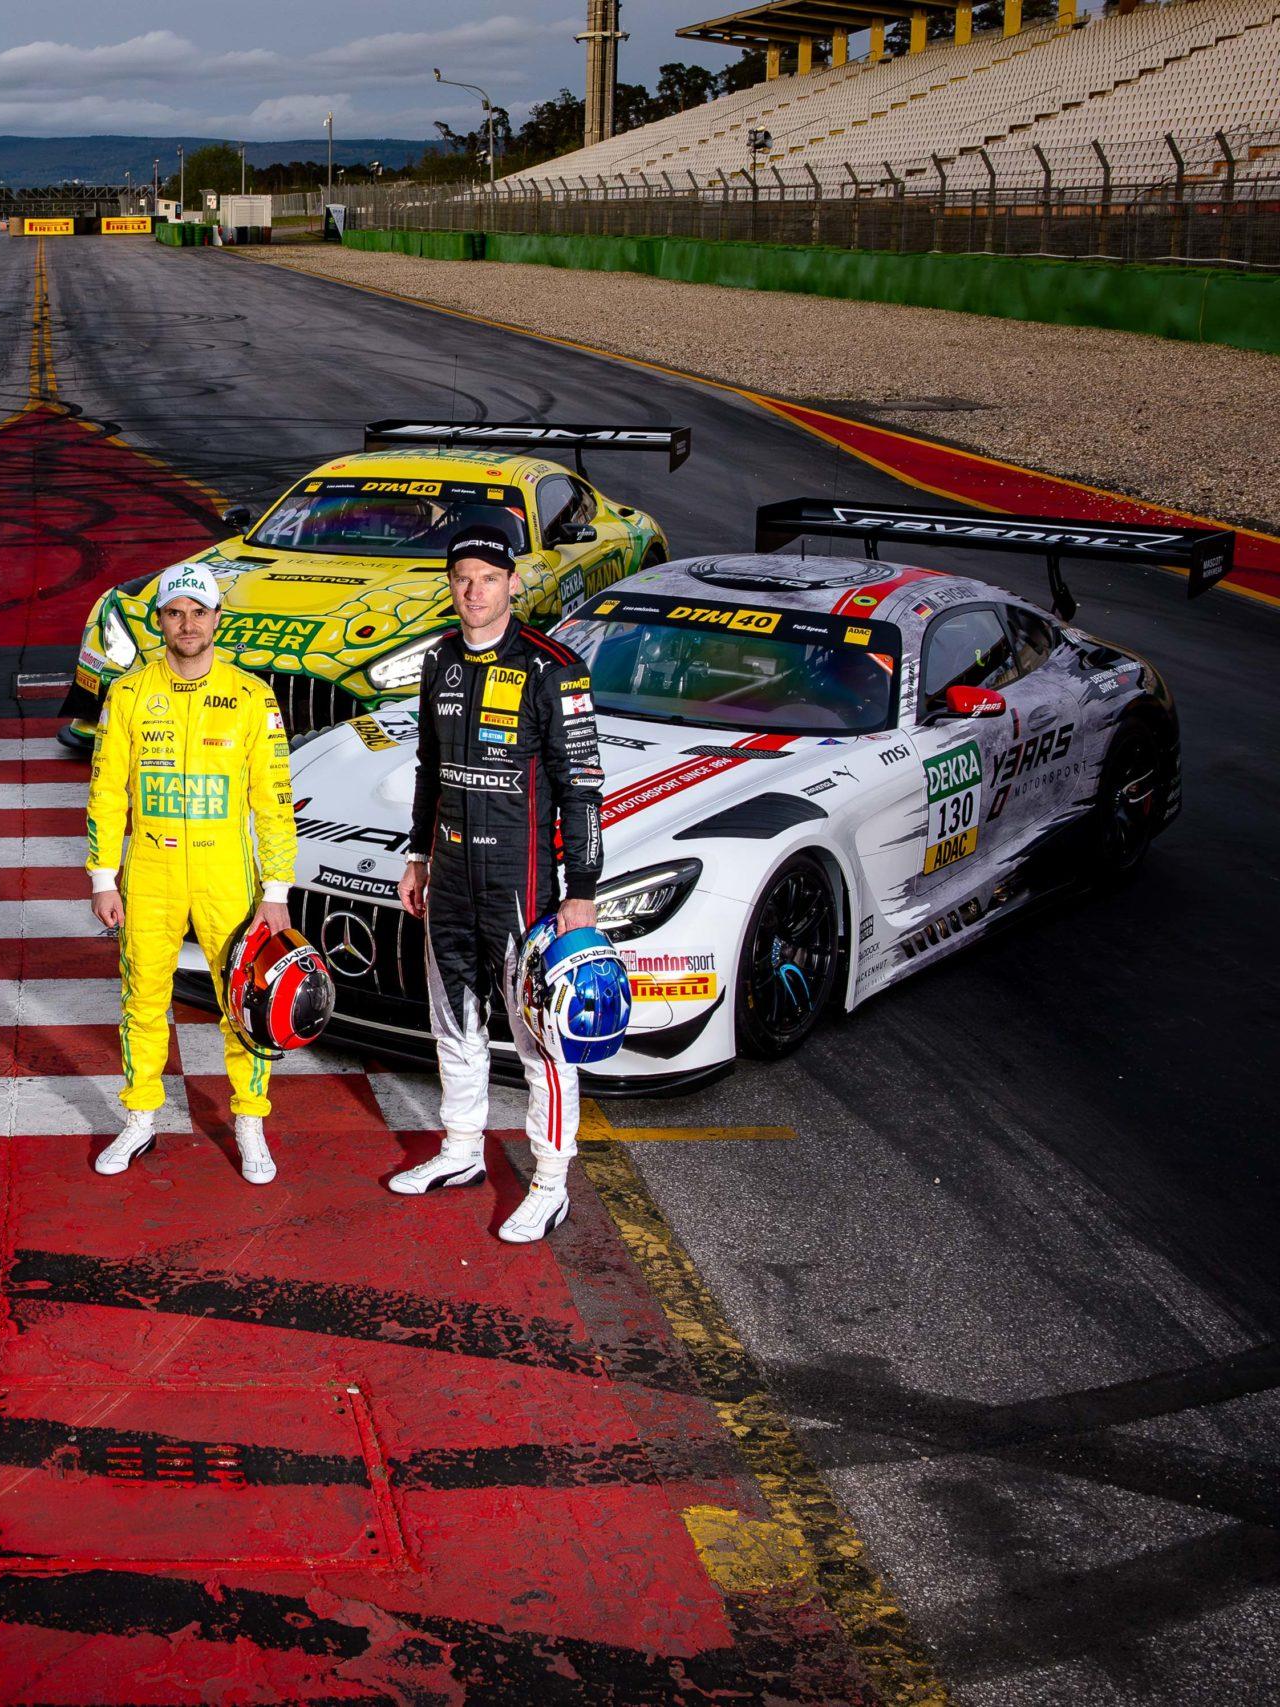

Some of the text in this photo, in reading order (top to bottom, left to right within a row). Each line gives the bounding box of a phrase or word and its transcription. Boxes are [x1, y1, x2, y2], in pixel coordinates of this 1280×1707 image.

[28, 220, 72, 232] PIRELLI
[106, 219, 148, 231] PIRELLI
[492, 427, 671, 442] AMG
[361, 481, 438, 494] DTM 40
[847, 517, 1129, 549] RAVENOL
[466, 539, 505, 551] AMG
[167, 578, 207, 593] DEKRA
[273, 573, 365, 586] RAVENOL
[560, 568, 585, 602] DEKRA
[666, 605, 773, 630] DTM 40
[793, 623, 829, 635] Full Speed.
[847, 627, 871, 636] ADAC
[488, 668, 525, 686] ADAC
[174, 683, 197, 692] DTM
[560, 680, 581, 691] DTM
[203, 694, 238, 710] ADAC
[484, 714, 515, 726] PIRELLI
[351, 720, 392, 747] ADAC
[202, 737, 232, 748] PIRELLI
[151, 747, 175, 755] DEKRA
[486, 746, 508, 757] IWC
[878, 744, 911, 767] msi
[441, 764, 512, 788] RAVENOL
[927, 749, 981, 797] DEKRA
[144, 774, 225, 797] MANN
[613, 777, 684, 816] MOTORSPORT
[682, 764, 712, 784] SINCE
[146, 797, 224, 816] FILTER
[937, 790, 974, 840] 130
[472, 836, 498, 846] MARO
[589, 806, 600, 861] RAVENOL
[192, 839, 216, 848] LUGGI
[932, 832, 968, 870] ADAC
[320, 870, 395, 897] RAVENOL
[628, 975, 710, 998] PIRELLI
